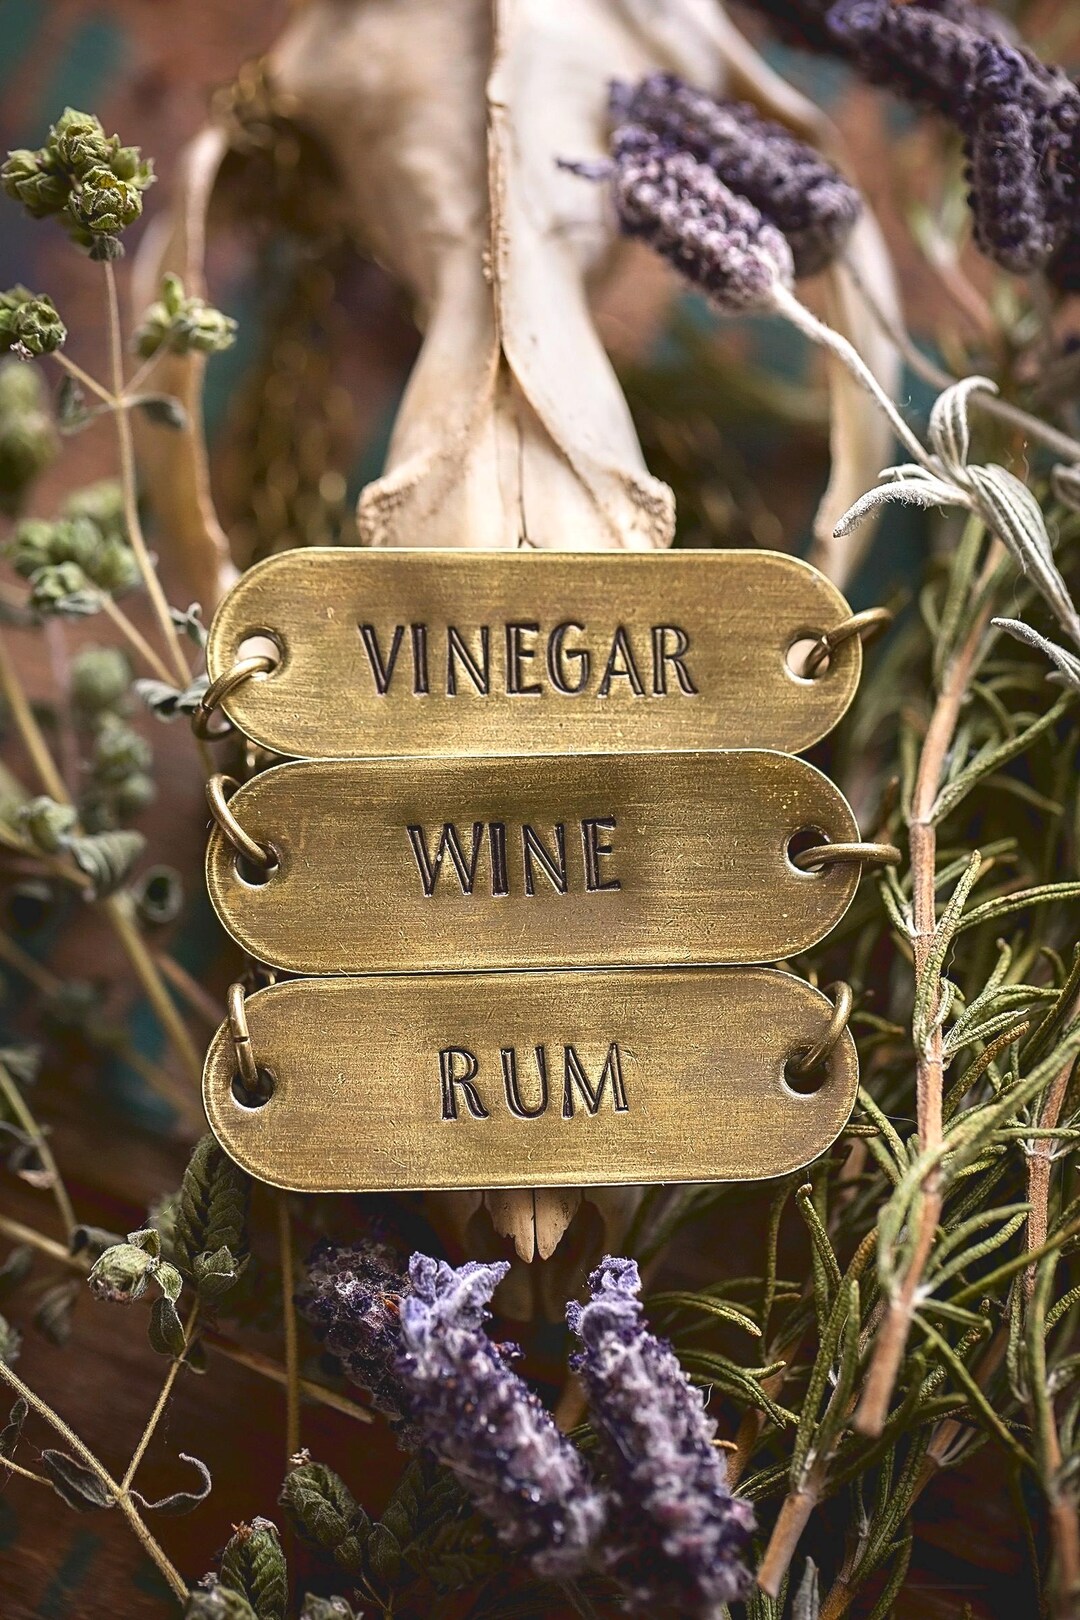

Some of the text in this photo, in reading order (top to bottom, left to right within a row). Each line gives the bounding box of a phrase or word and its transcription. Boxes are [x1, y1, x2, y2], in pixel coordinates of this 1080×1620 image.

[358, 621, 699, 698] VINEGAR
[406, 816, 622, 897] WINE
[438, 1042, 630, 1121] RUM
